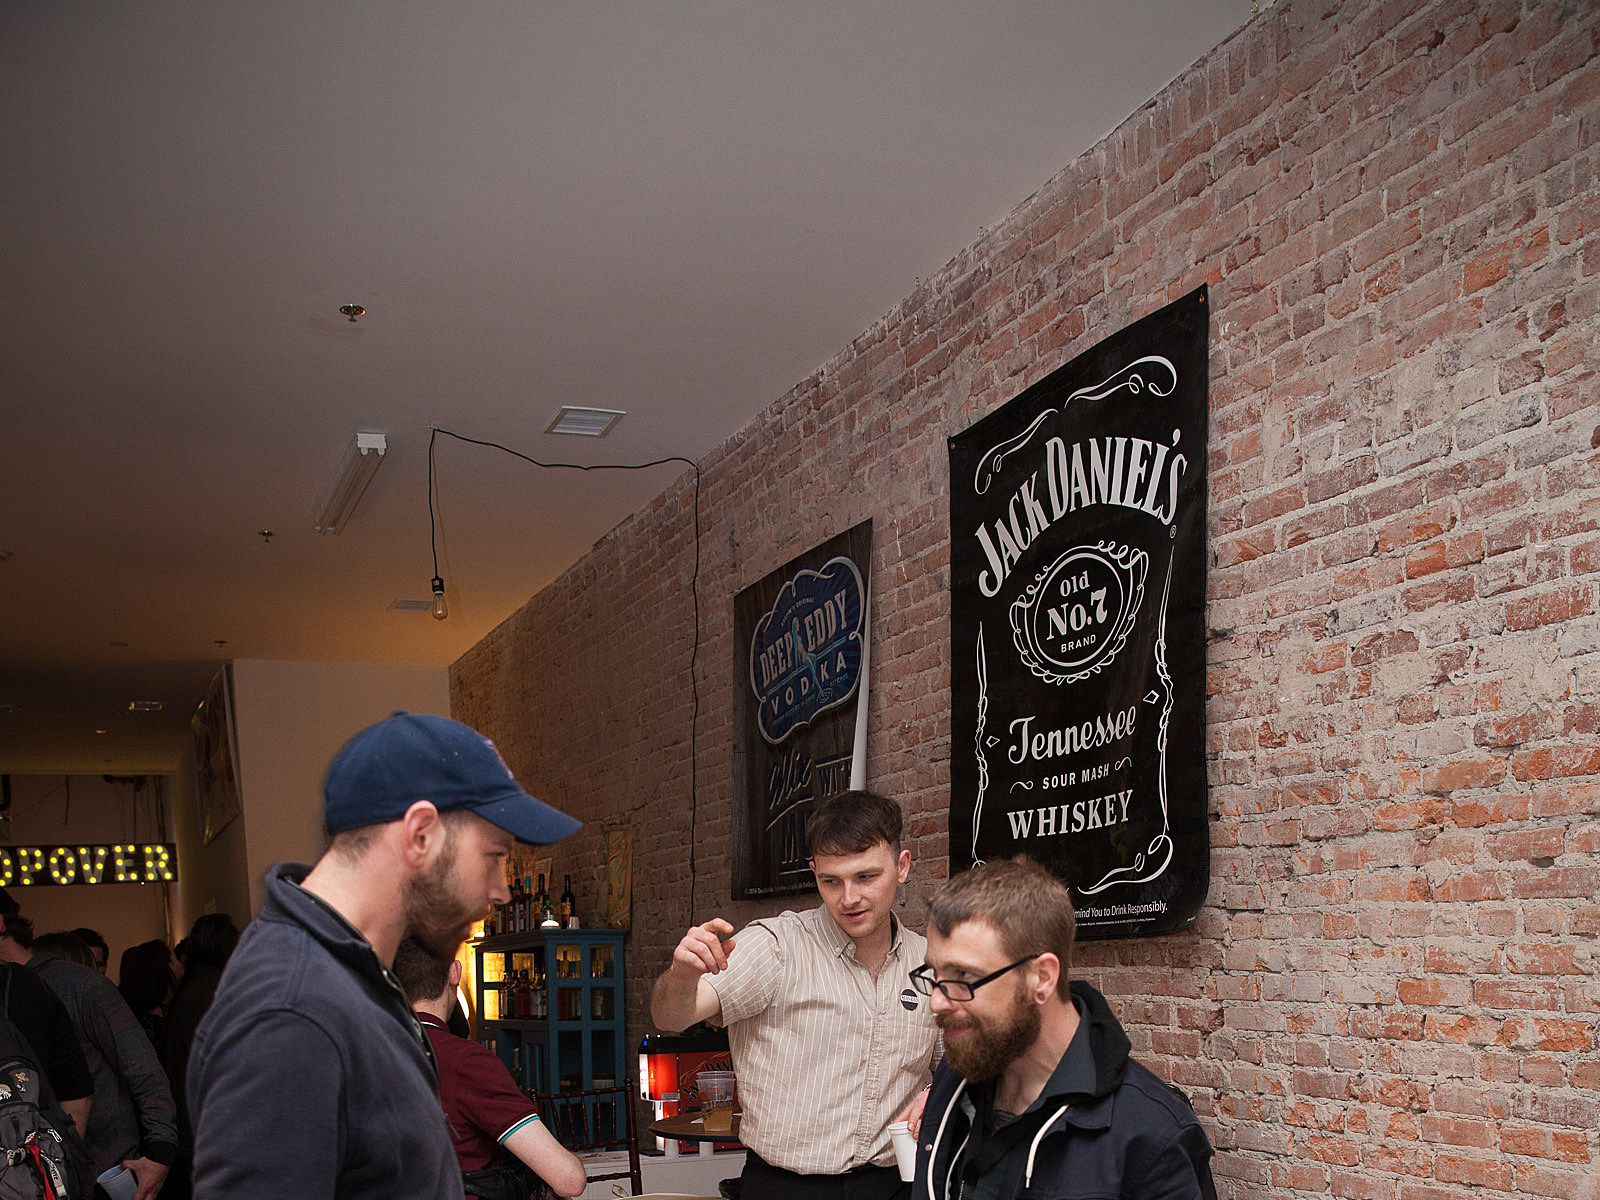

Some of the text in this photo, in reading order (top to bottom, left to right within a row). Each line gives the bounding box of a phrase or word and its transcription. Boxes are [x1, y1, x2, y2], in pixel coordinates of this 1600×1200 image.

[974, 428, 1188, 598] JACK DANIEL'S
[759, 588, 848, 688] DEEP EDDY
[1060, 634, 1097, 653] BRAND
[1008, 705, 1136, 764] Tennessee
[1042, 763, 1110, 790] SOUR MASH
[1006, 789, 1133, 840] WHISKEY
[1073, 899, 1168, 919] mind You to Drink Responsibly.
